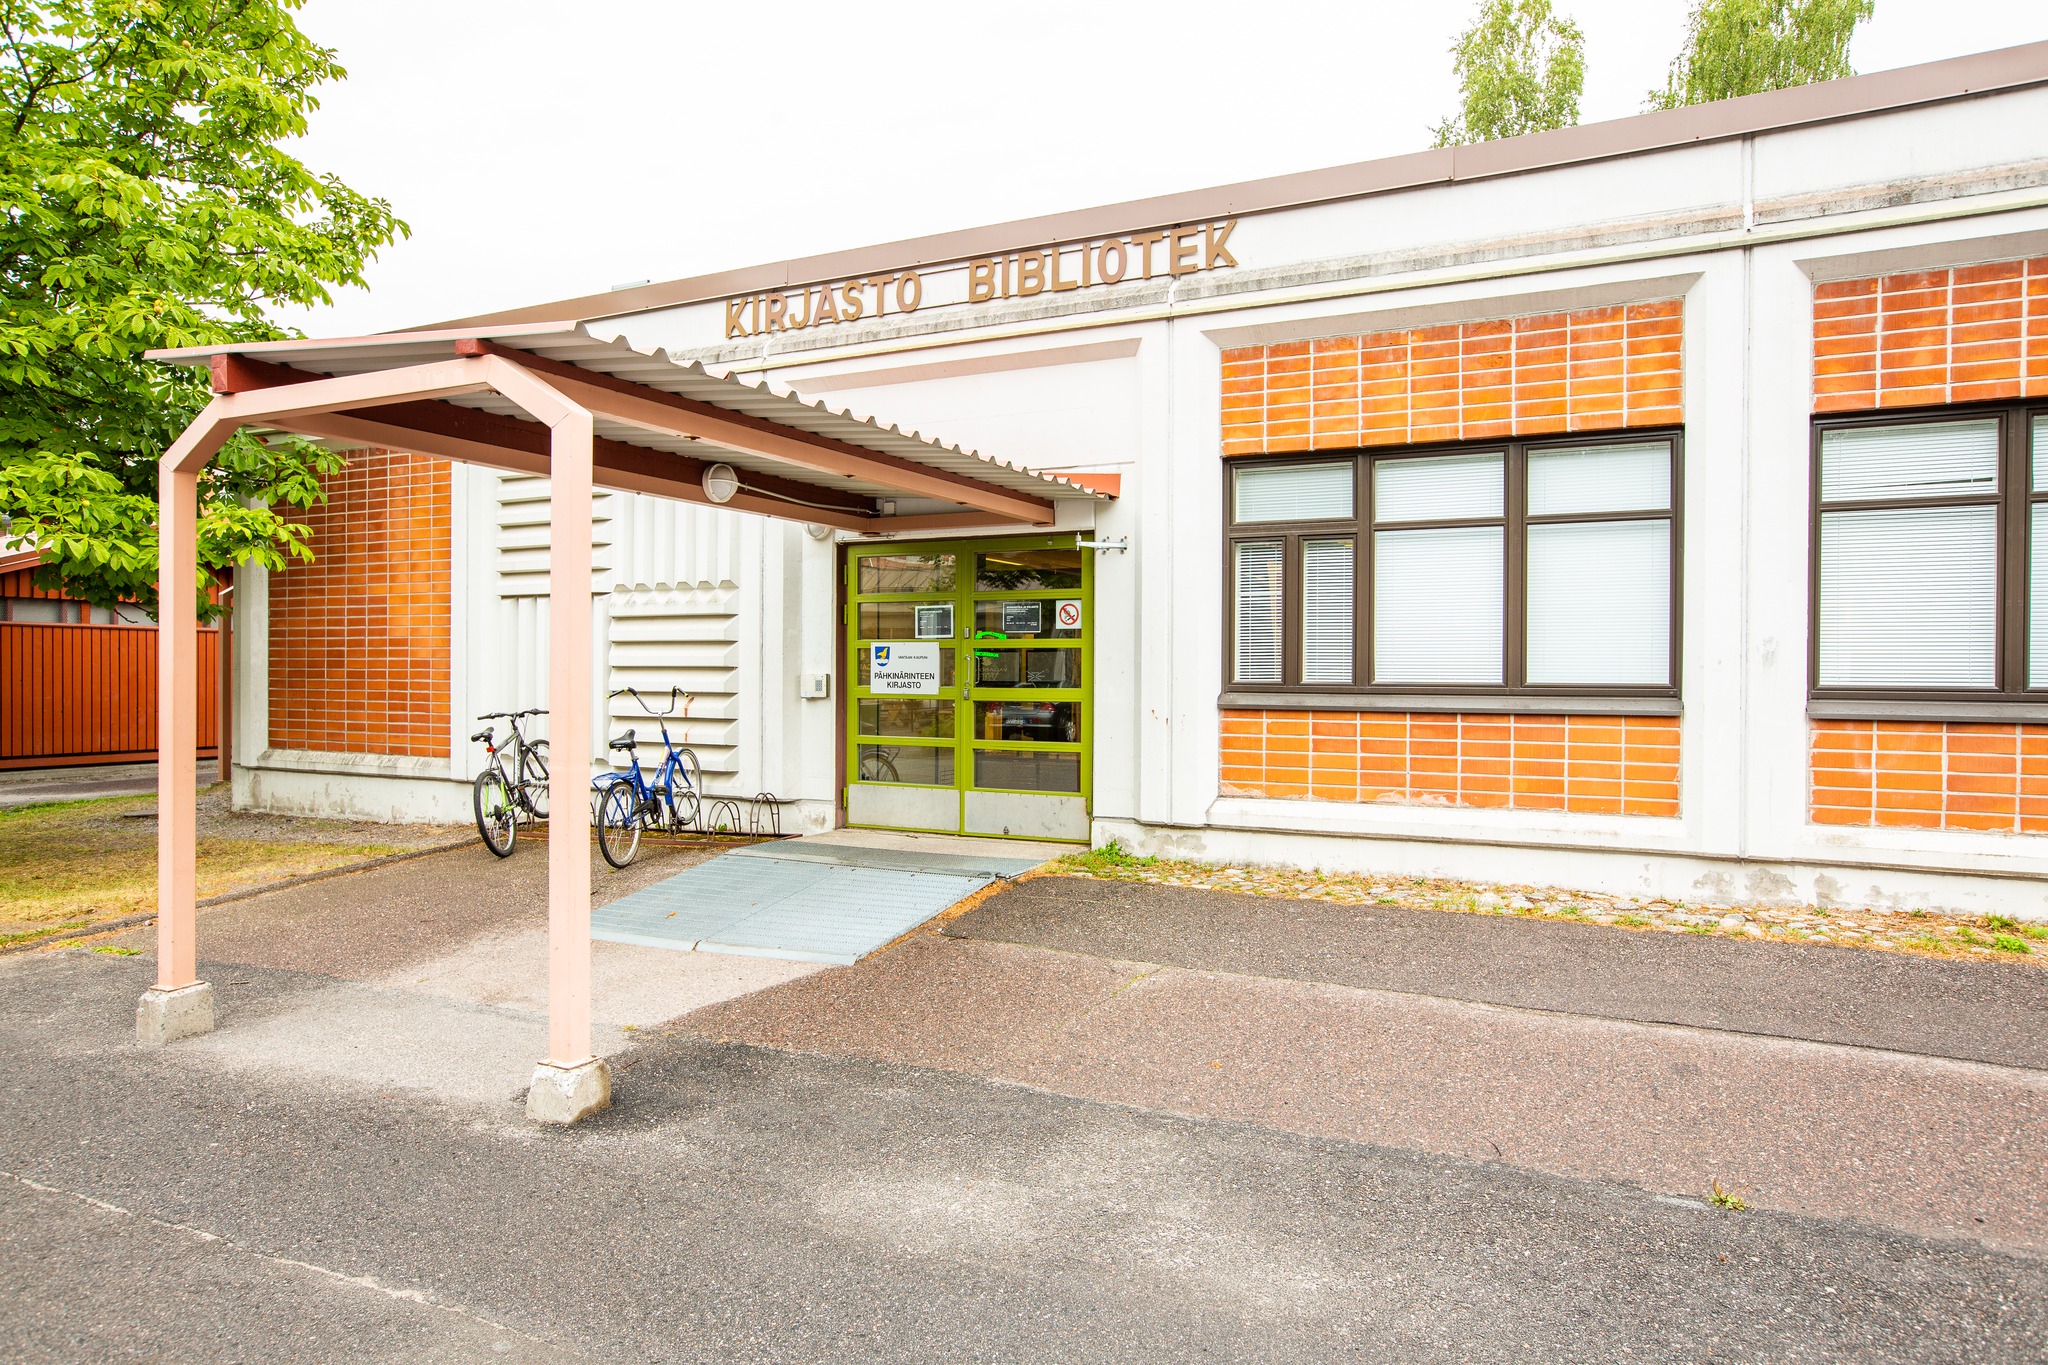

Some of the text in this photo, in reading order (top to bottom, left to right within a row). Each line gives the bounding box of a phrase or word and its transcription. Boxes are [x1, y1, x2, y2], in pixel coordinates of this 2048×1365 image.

[725, 218, 1238, 339] KIRJASTO BIBLIOTEK
[874, 671, 935, 680] PÄHKINÄRINTEEN
